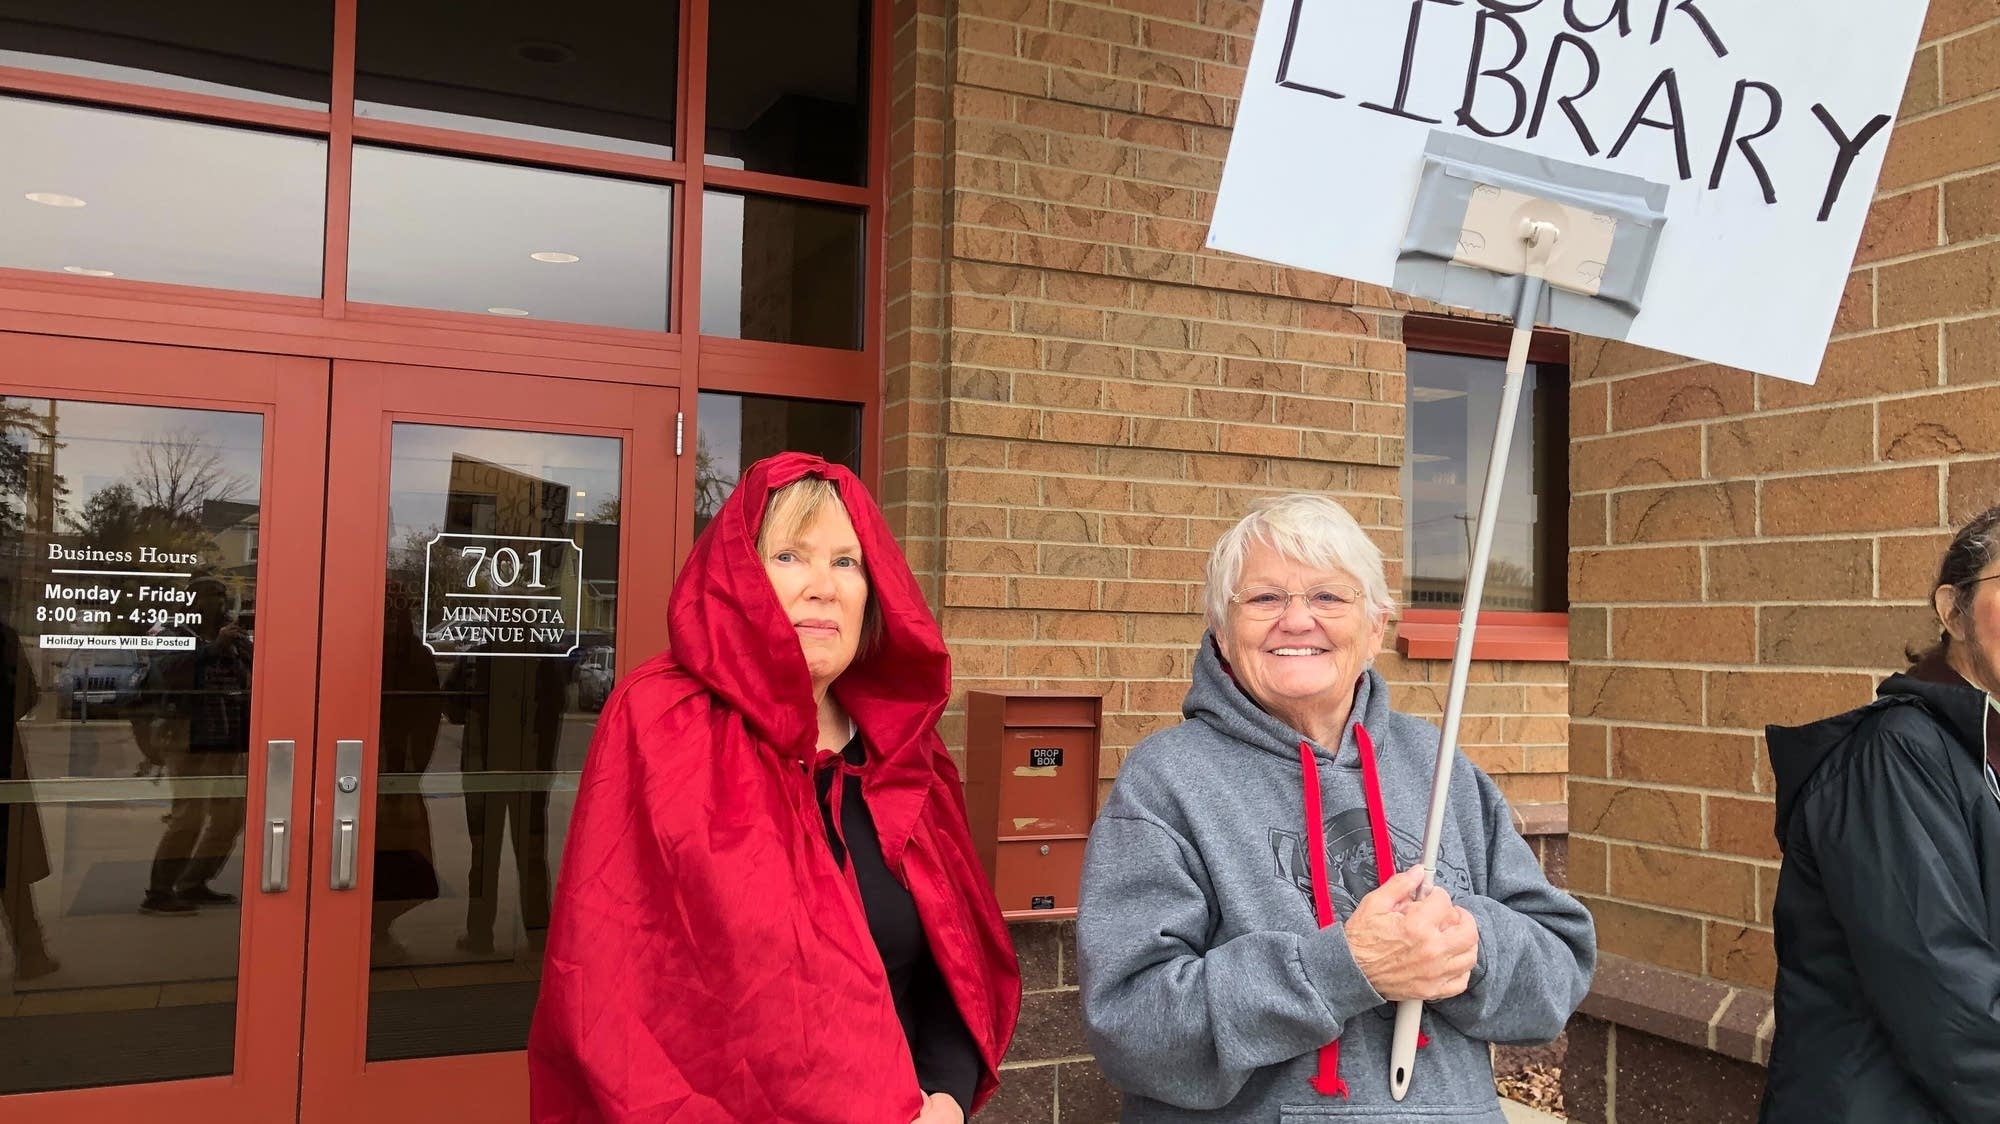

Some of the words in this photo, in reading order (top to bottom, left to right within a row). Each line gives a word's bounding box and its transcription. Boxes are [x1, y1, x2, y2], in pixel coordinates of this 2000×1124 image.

[1275, 0, 1893, 222] LIBRARY
[47, 543, 133, 562] Business
[138, 547, 198, 564] Hours
[461, 546, 546, 588] 701
[45, 583, 121, 604] Monday
[139, 586, 197, 606] Friday
[36, 606, 77, 622] 8:00
[82, 611, 111, 623] am
[129, 608, 168, 624] 4:30
[174, 613, 202, 627] pm
[441, 606, 565, 624] MINNESOTA
[46, 636, 84, 647] Holiday
[87, 637, 117, 646] Hours
[120, 637, 138, 646] Will
[141, 638, 154, 646] Be
[156, 638, 190, 647] Posted
[440, 626, 524, 642] AVENUE
[530, 628, 565, 643] NW
[1033, 749, 1060, 758] DROP
[1037, 757, 1056, 766] BOX
